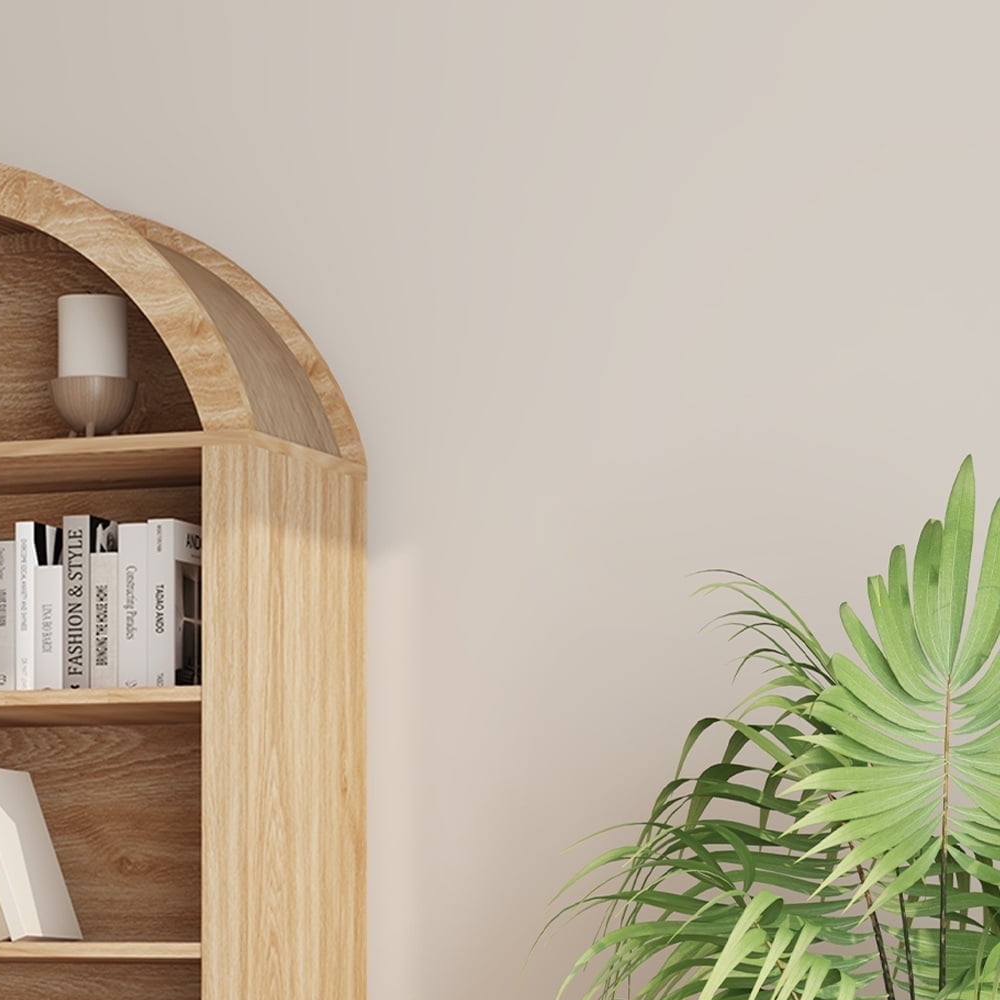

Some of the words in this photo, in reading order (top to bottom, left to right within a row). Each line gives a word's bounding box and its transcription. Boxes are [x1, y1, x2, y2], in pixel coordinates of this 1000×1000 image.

[67, 529, 84, 581] STYLE
[67, 584, 84, 598] &
[154, 584, 165, 611] TADAO
[154, 611, 165, 634] ANDO
[67, 602, 84, 676] FASHION
